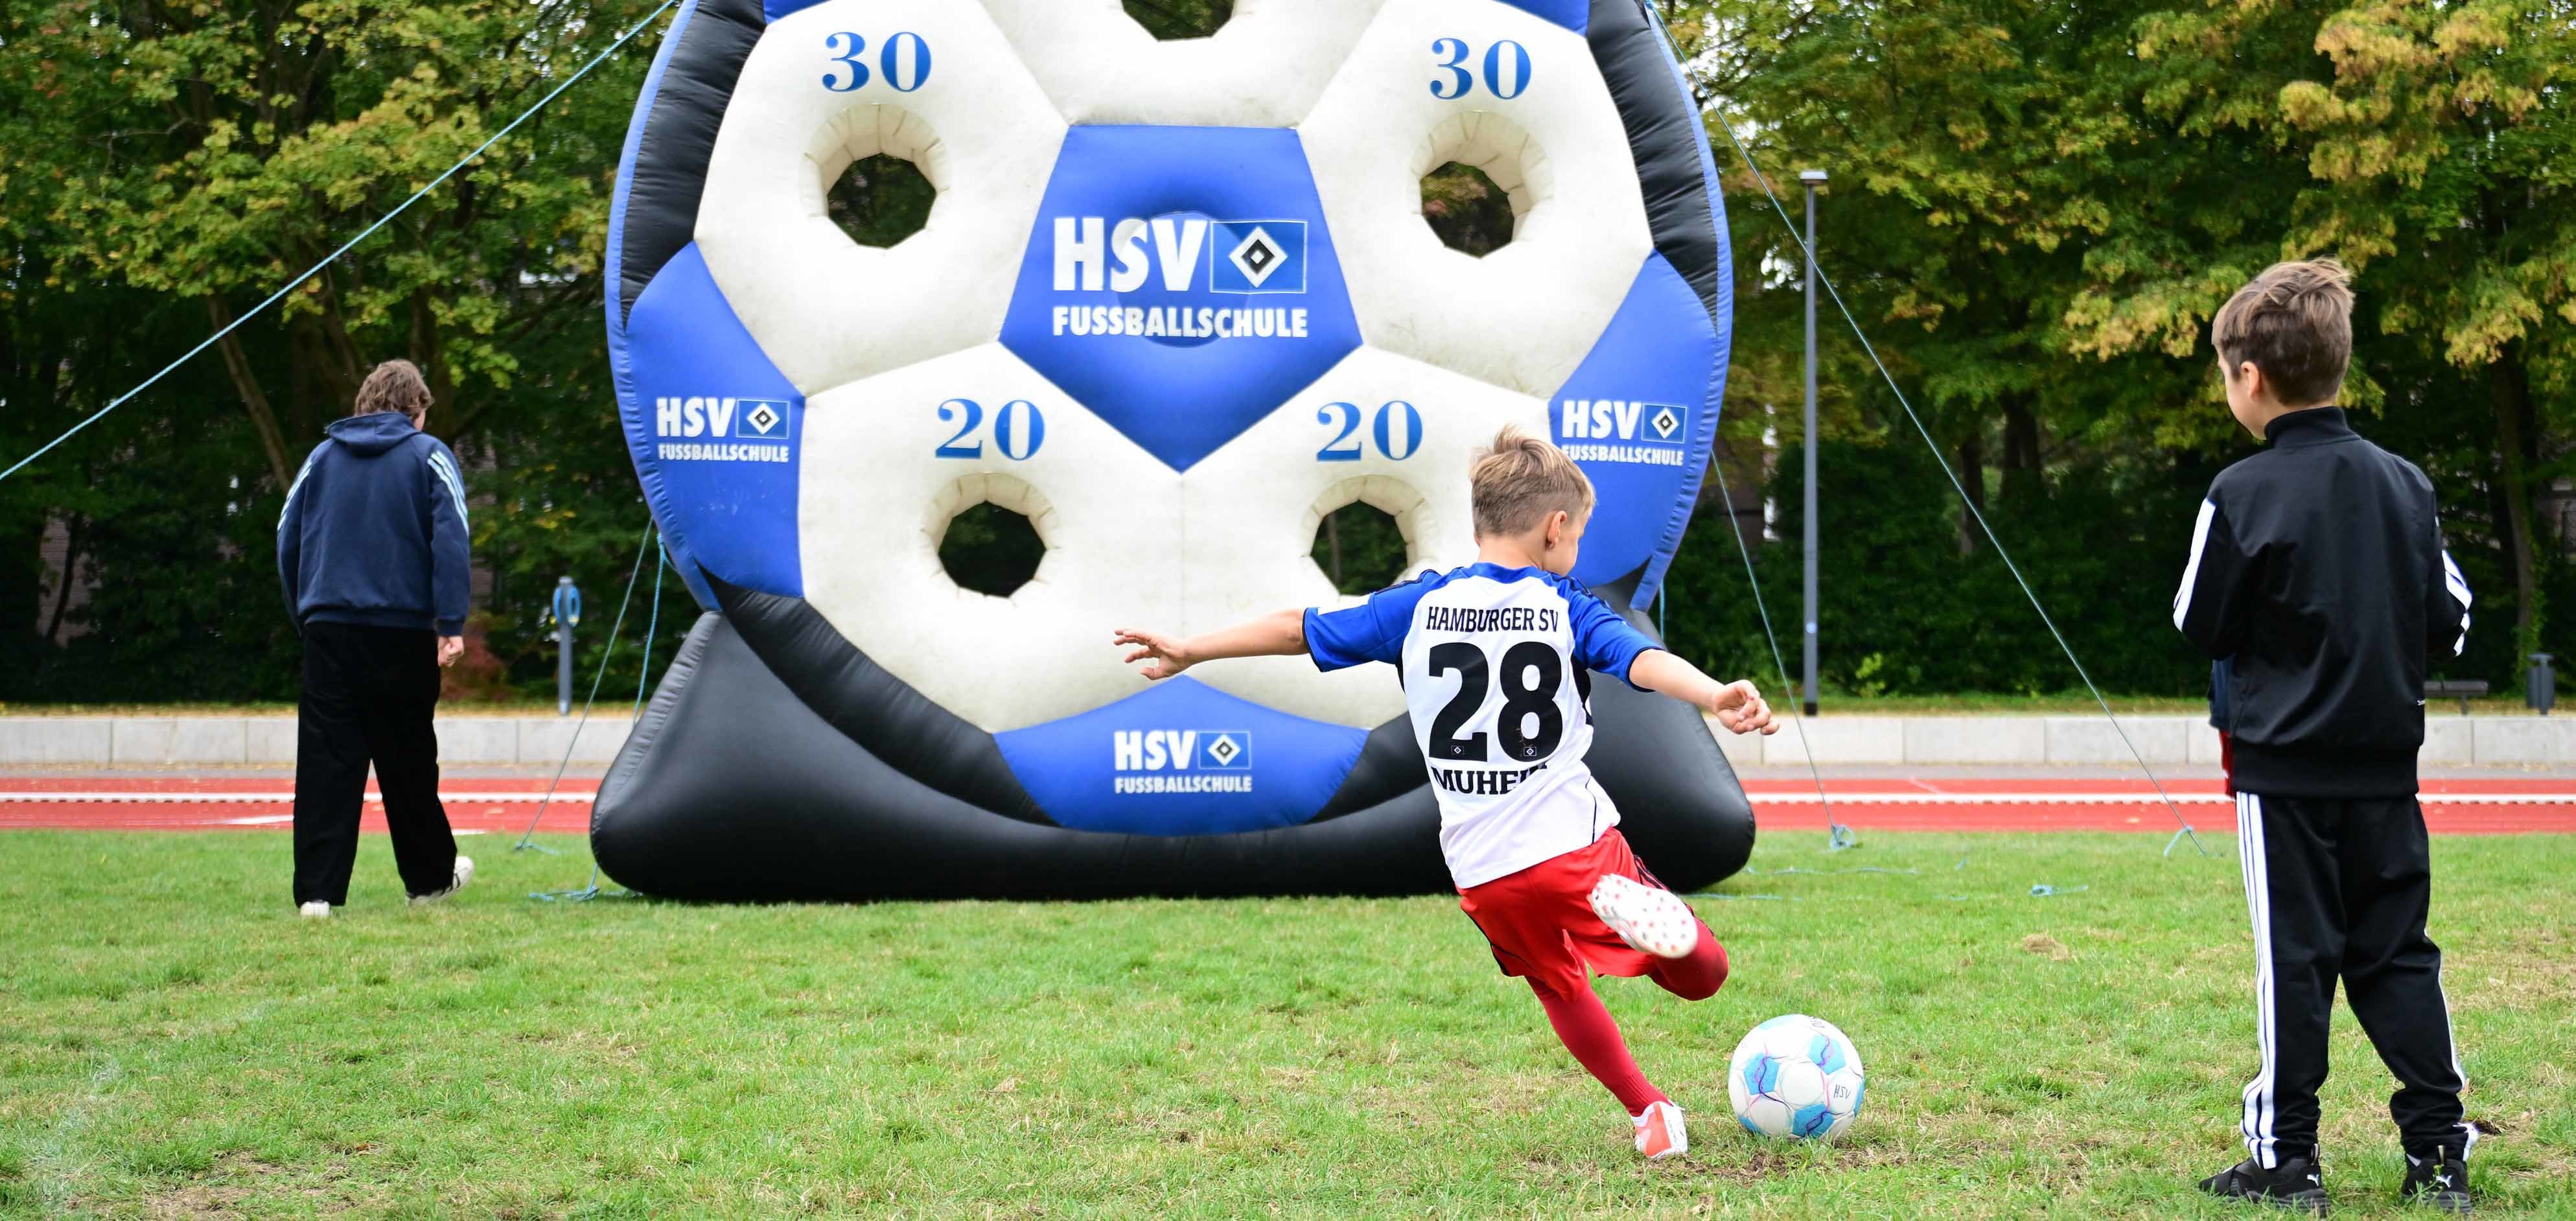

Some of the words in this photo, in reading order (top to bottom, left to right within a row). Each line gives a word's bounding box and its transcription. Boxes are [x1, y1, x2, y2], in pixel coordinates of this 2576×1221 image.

[822, 31, 932, 92] 30
[1430, 38, 1531, 100] 30
[1053, 217, 1207, 292] HSV
[1053, 306, 1308, 338] FUSSBALLSCHULE
[656, 397, 736, 437] HSV
[935, 399, 1045, 461] 20
[1316, 401, 1423, 461] 20
[1562, 400, 1642, 440] HSV
[658, 443, 789, 463] FUSSBALLSCHULE
[1426, 606, 1535, 633] HAMBURGER
[1538, 609, 1559, 633] SV
[1429, 642, 1563, 762] 28
[1114, 730, 1196, 771] HSV
[1115, 776, 1252, 795] FUSSBALLSCHULE
[1833, 1084, 1851, 1100] HSV
